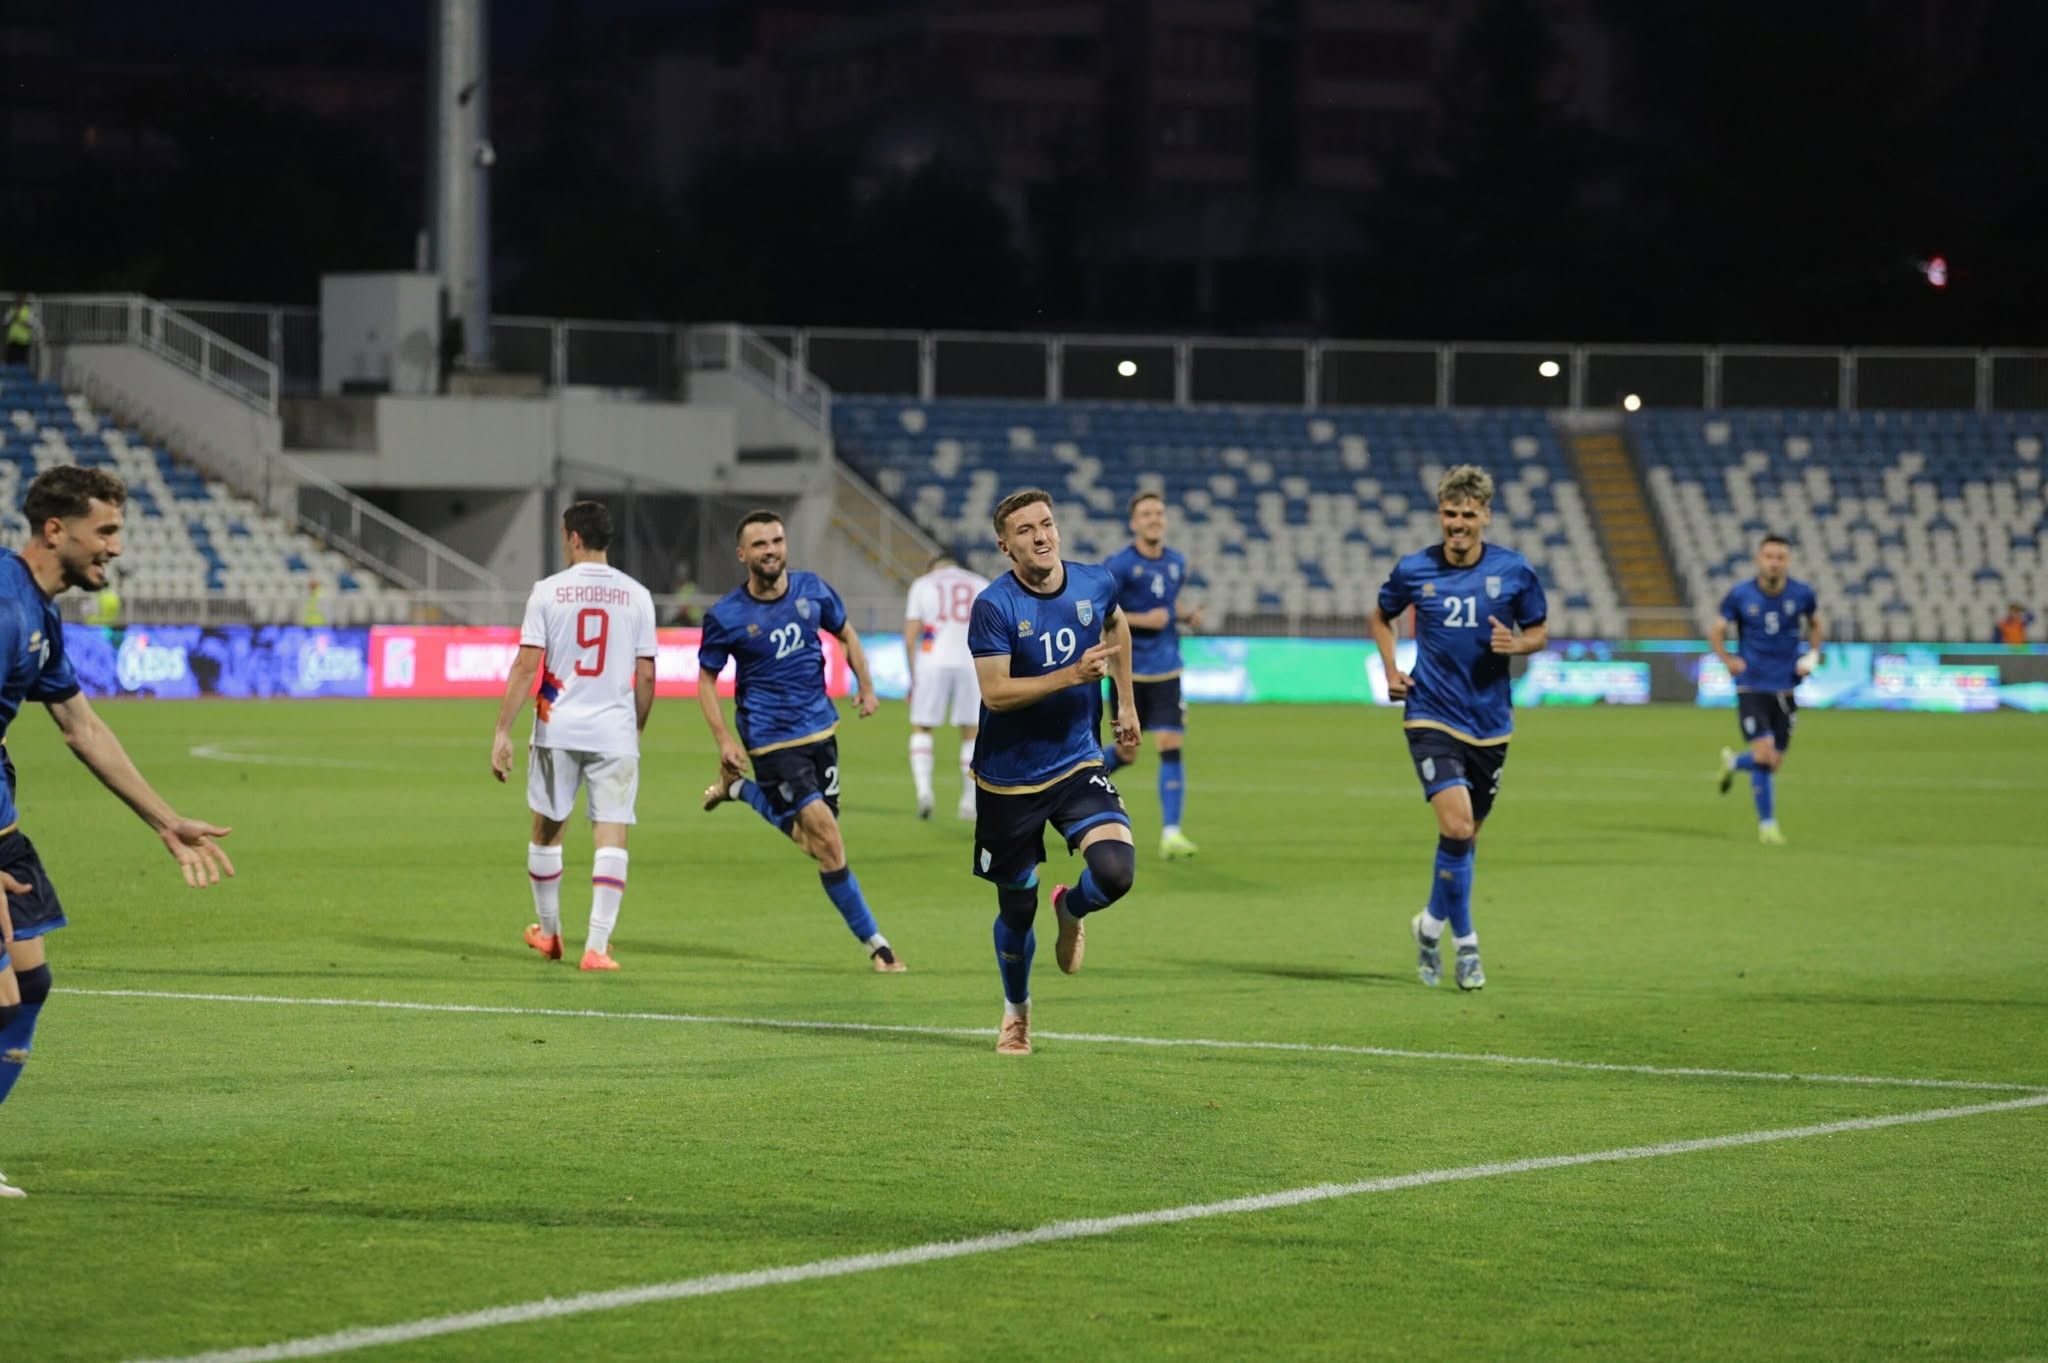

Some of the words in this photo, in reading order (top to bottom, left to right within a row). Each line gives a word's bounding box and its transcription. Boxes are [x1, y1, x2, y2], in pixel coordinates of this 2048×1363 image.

[556, 586, 630, 607] SEROBYAN
[936, 581, 972, 624] 18
[1150, 573, 1165, 599] 4
[1443, 596, 1479, 627] 21
[575, 608, 609, 677] 9
[769, 622, 805, 660] 22
[1039, 627, 1076, 667] 19
